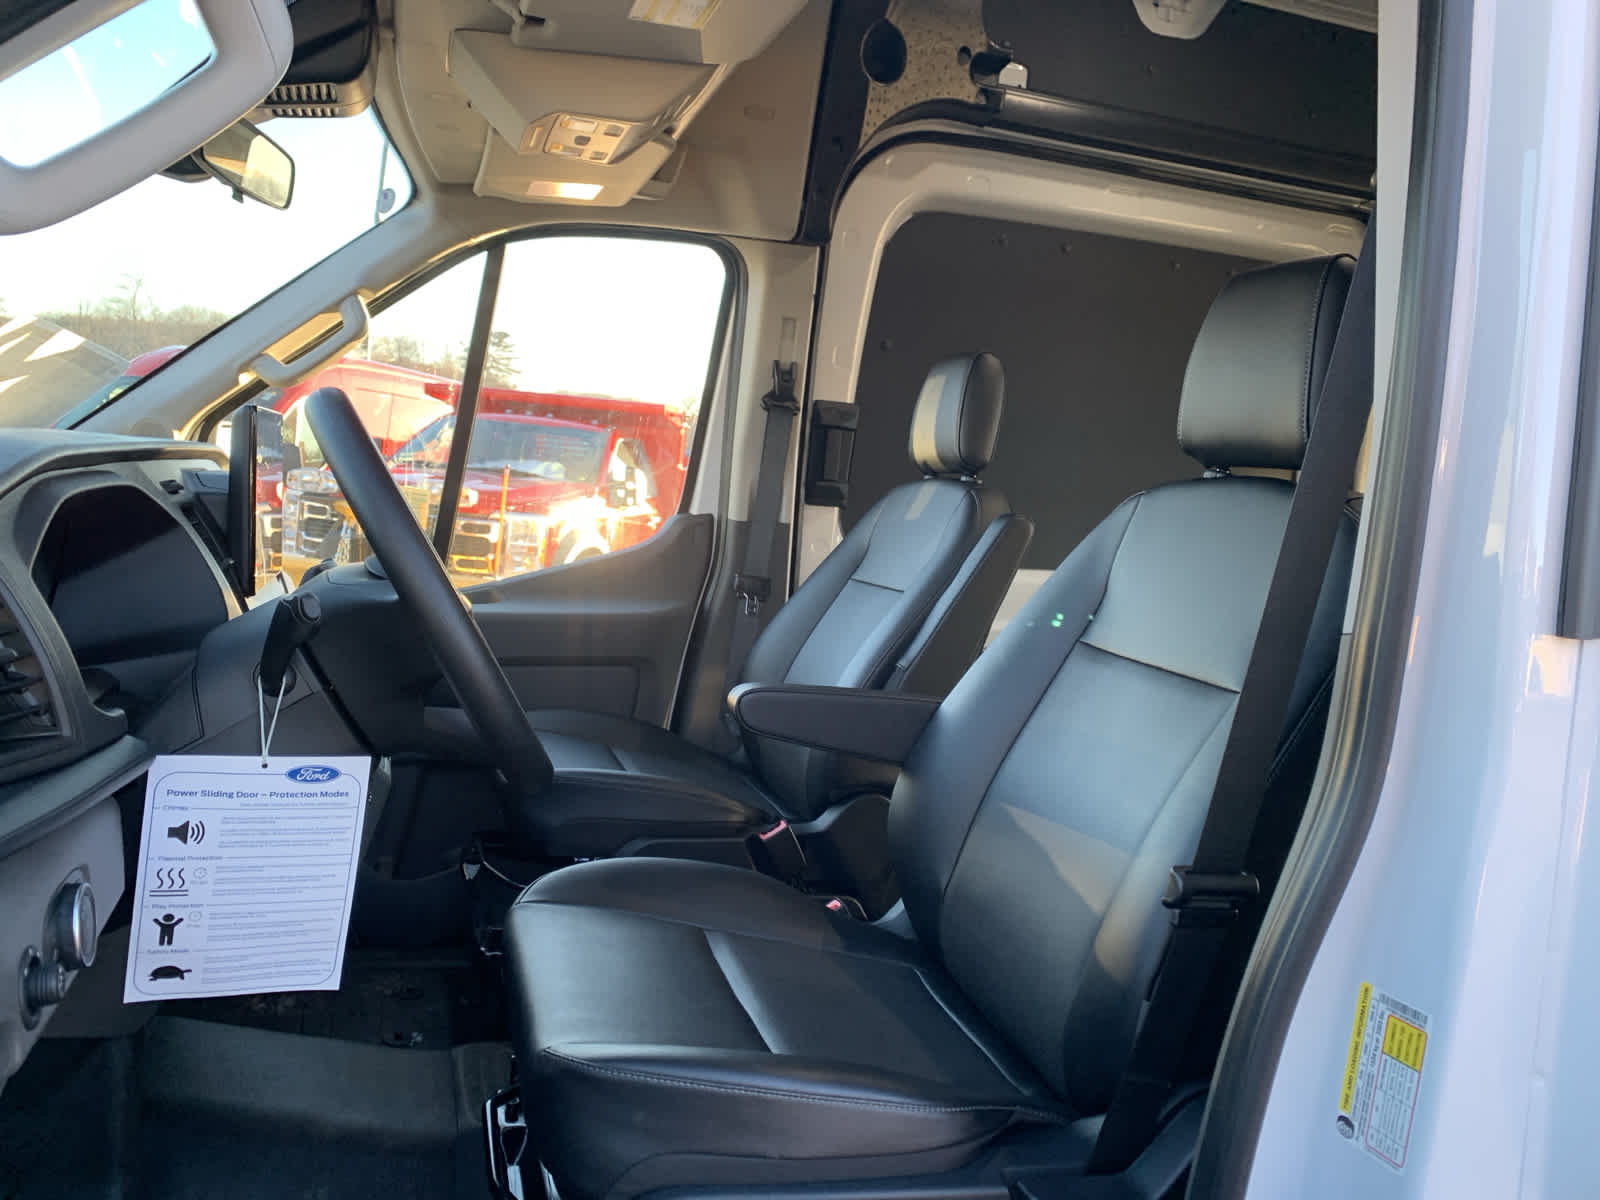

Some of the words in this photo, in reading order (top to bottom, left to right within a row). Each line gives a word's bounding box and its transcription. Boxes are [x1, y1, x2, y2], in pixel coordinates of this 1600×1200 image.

[166, 789, 198, 797] Power
[200, 789, 234, 799] Sliding
[236, 791, 259, 799] Door
[269, 791, 318, 799] Protection
[320, 790, 350, 798] Modes
